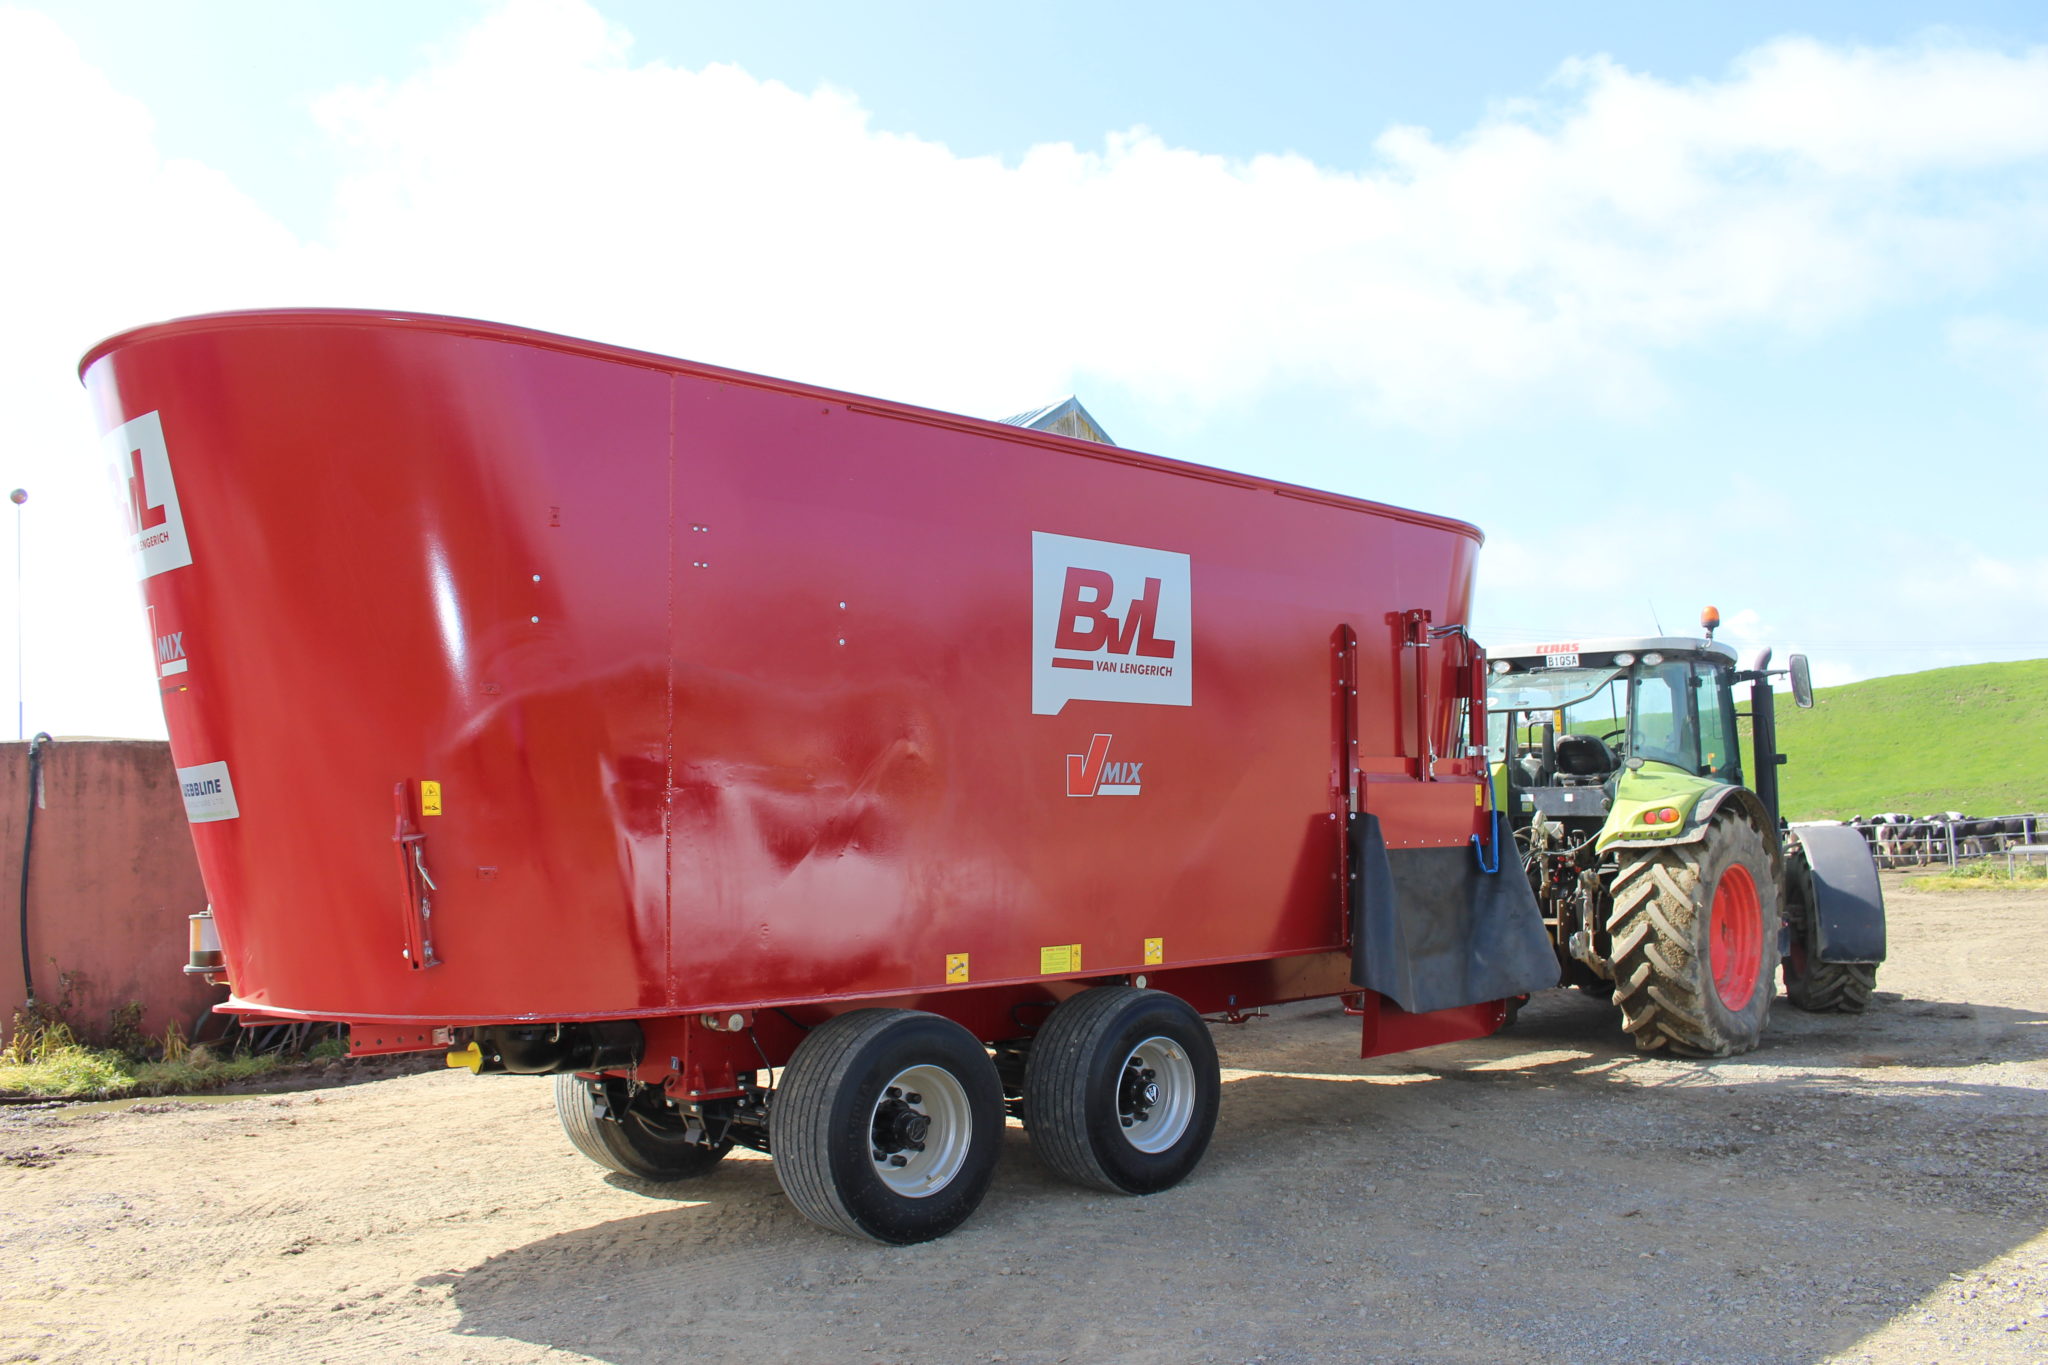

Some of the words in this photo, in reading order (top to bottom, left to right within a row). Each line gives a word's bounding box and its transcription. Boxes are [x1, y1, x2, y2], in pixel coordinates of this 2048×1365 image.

[138, 531, 169, 551] ENGERICH
[158, 631, 186, 663] MIX
[1536, 643, 1580, 654] CLAAS
[1096, 660, 1117, 673] VAN
[1120, 663, 1173, 677] LENGERICH
[1101, 762, 1143, 783] MIX
